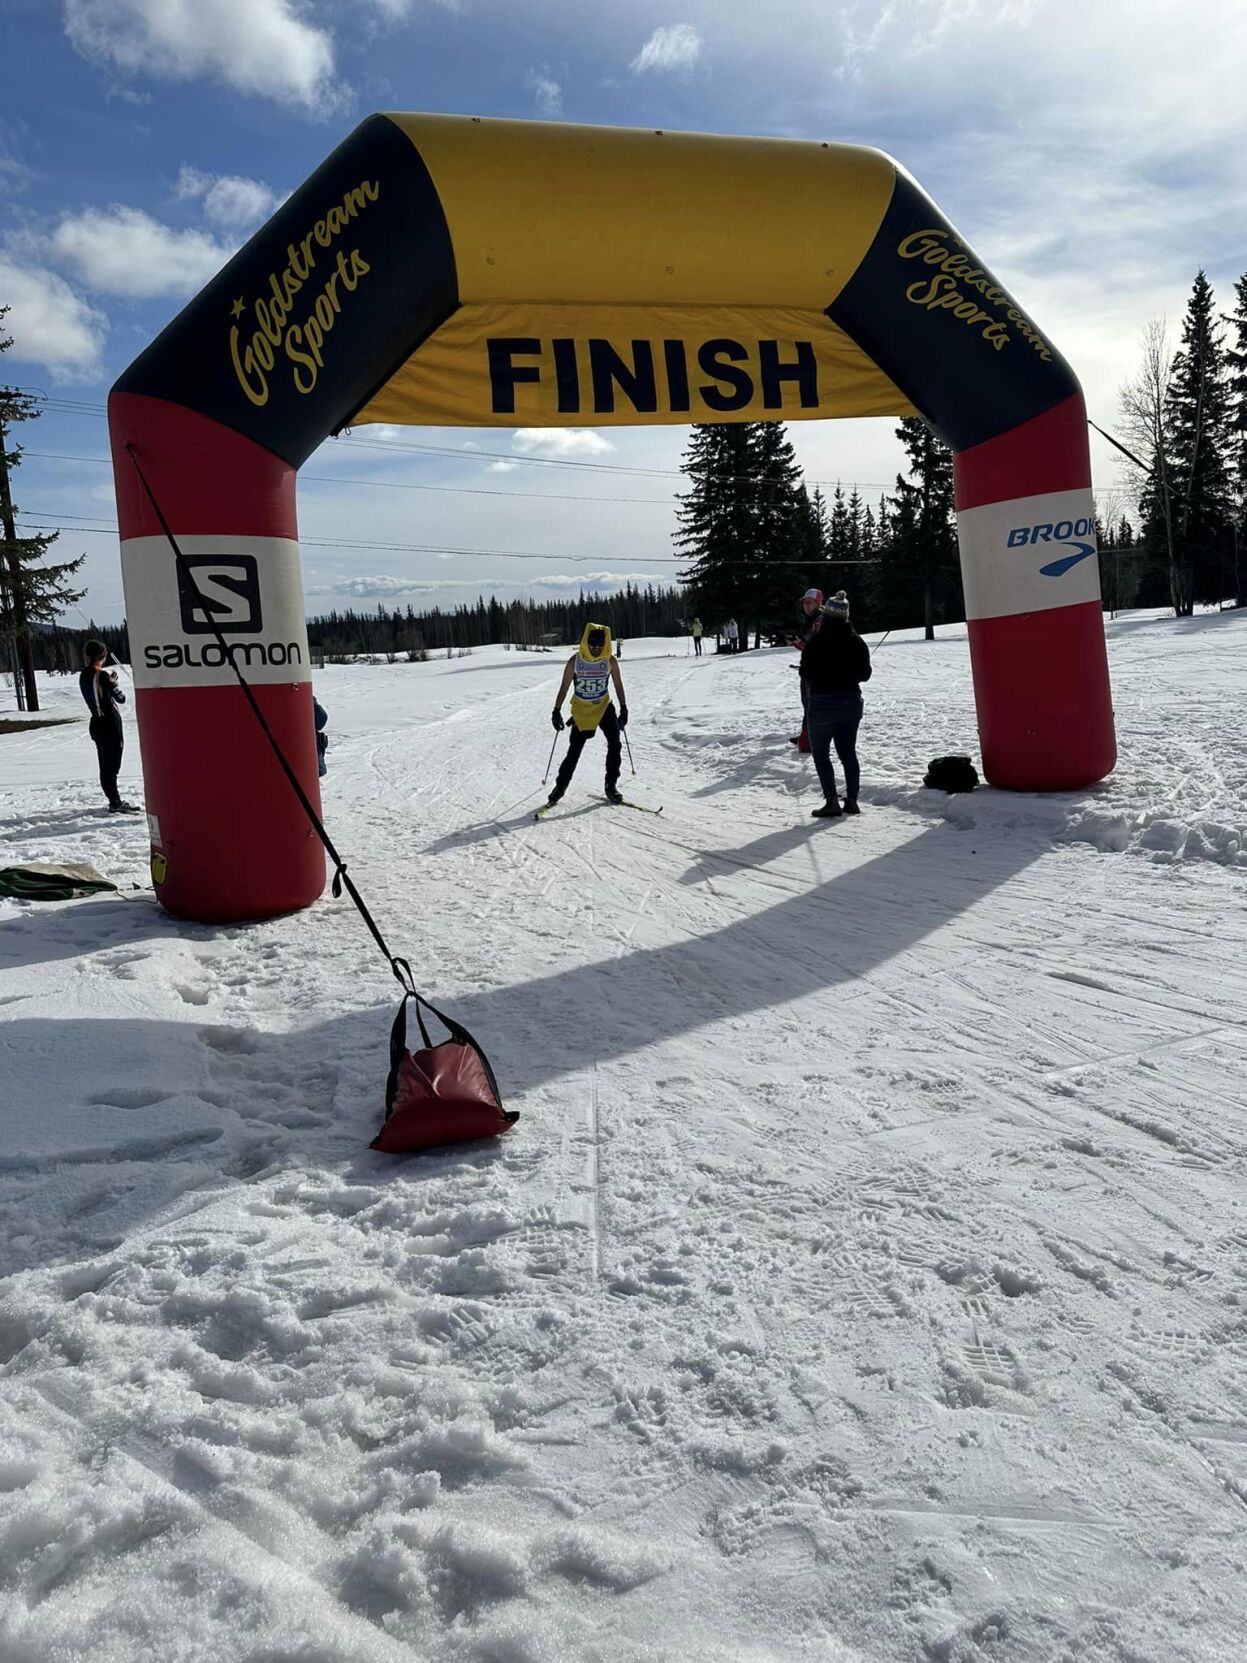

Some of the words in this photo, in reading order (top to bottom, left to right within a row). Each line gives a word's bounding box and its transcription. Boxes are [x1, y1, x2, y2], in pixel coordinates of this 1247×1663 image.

[231, 181, 379, 406] Goldstream
[285, 249, 370, 394] Sports
[897, 229, 1052, 362] Goldstream
[906, 275, 1010, 351] Sports
[486, 338, 819, 414] FINISH
[575, 679, 606, 692] 253
